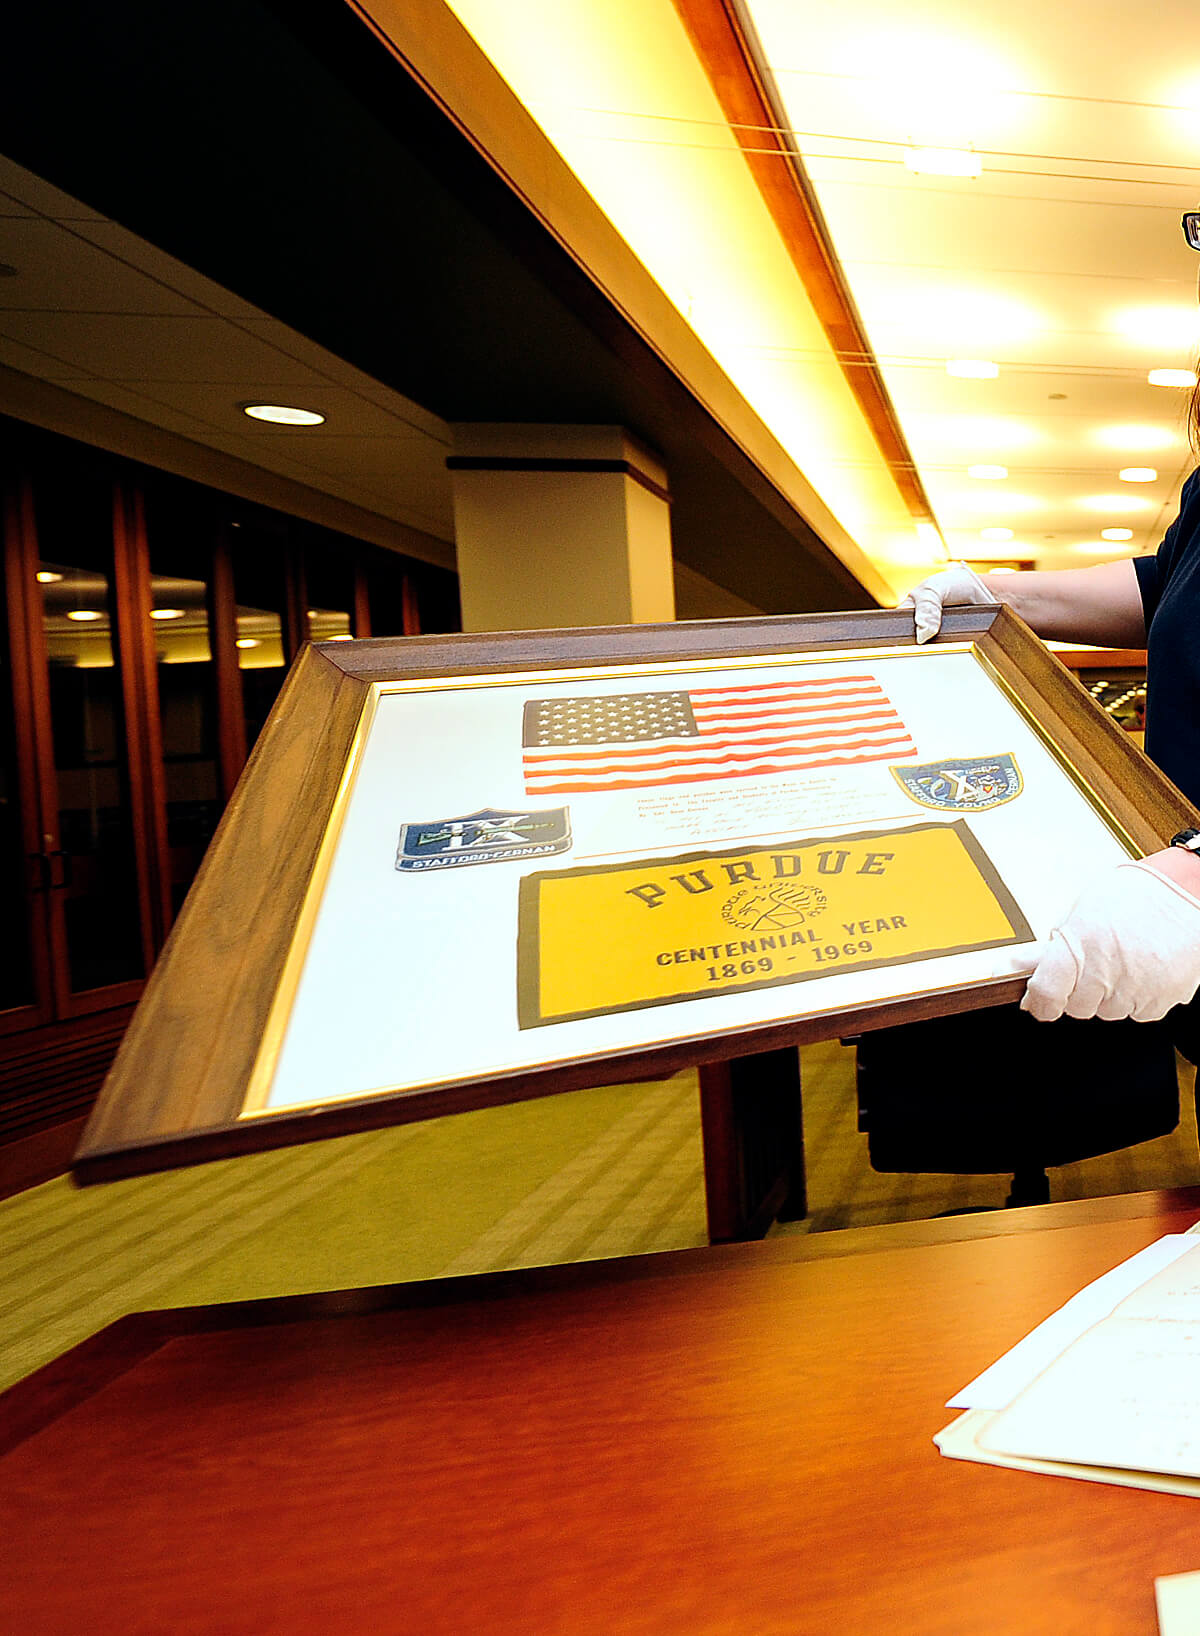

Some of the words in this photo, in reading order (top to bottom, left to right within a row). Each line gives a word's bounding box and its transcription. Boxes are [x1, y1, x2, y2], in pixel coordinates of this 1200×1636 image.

[625, 850, 895, 909] PURDUE
[656, 929, 822, 967] CENTENNIAL
[842, 915, 908, 938] YEAR
[706, 956, 774, 982] 1869
[812, 939, 874, 964] 1969
